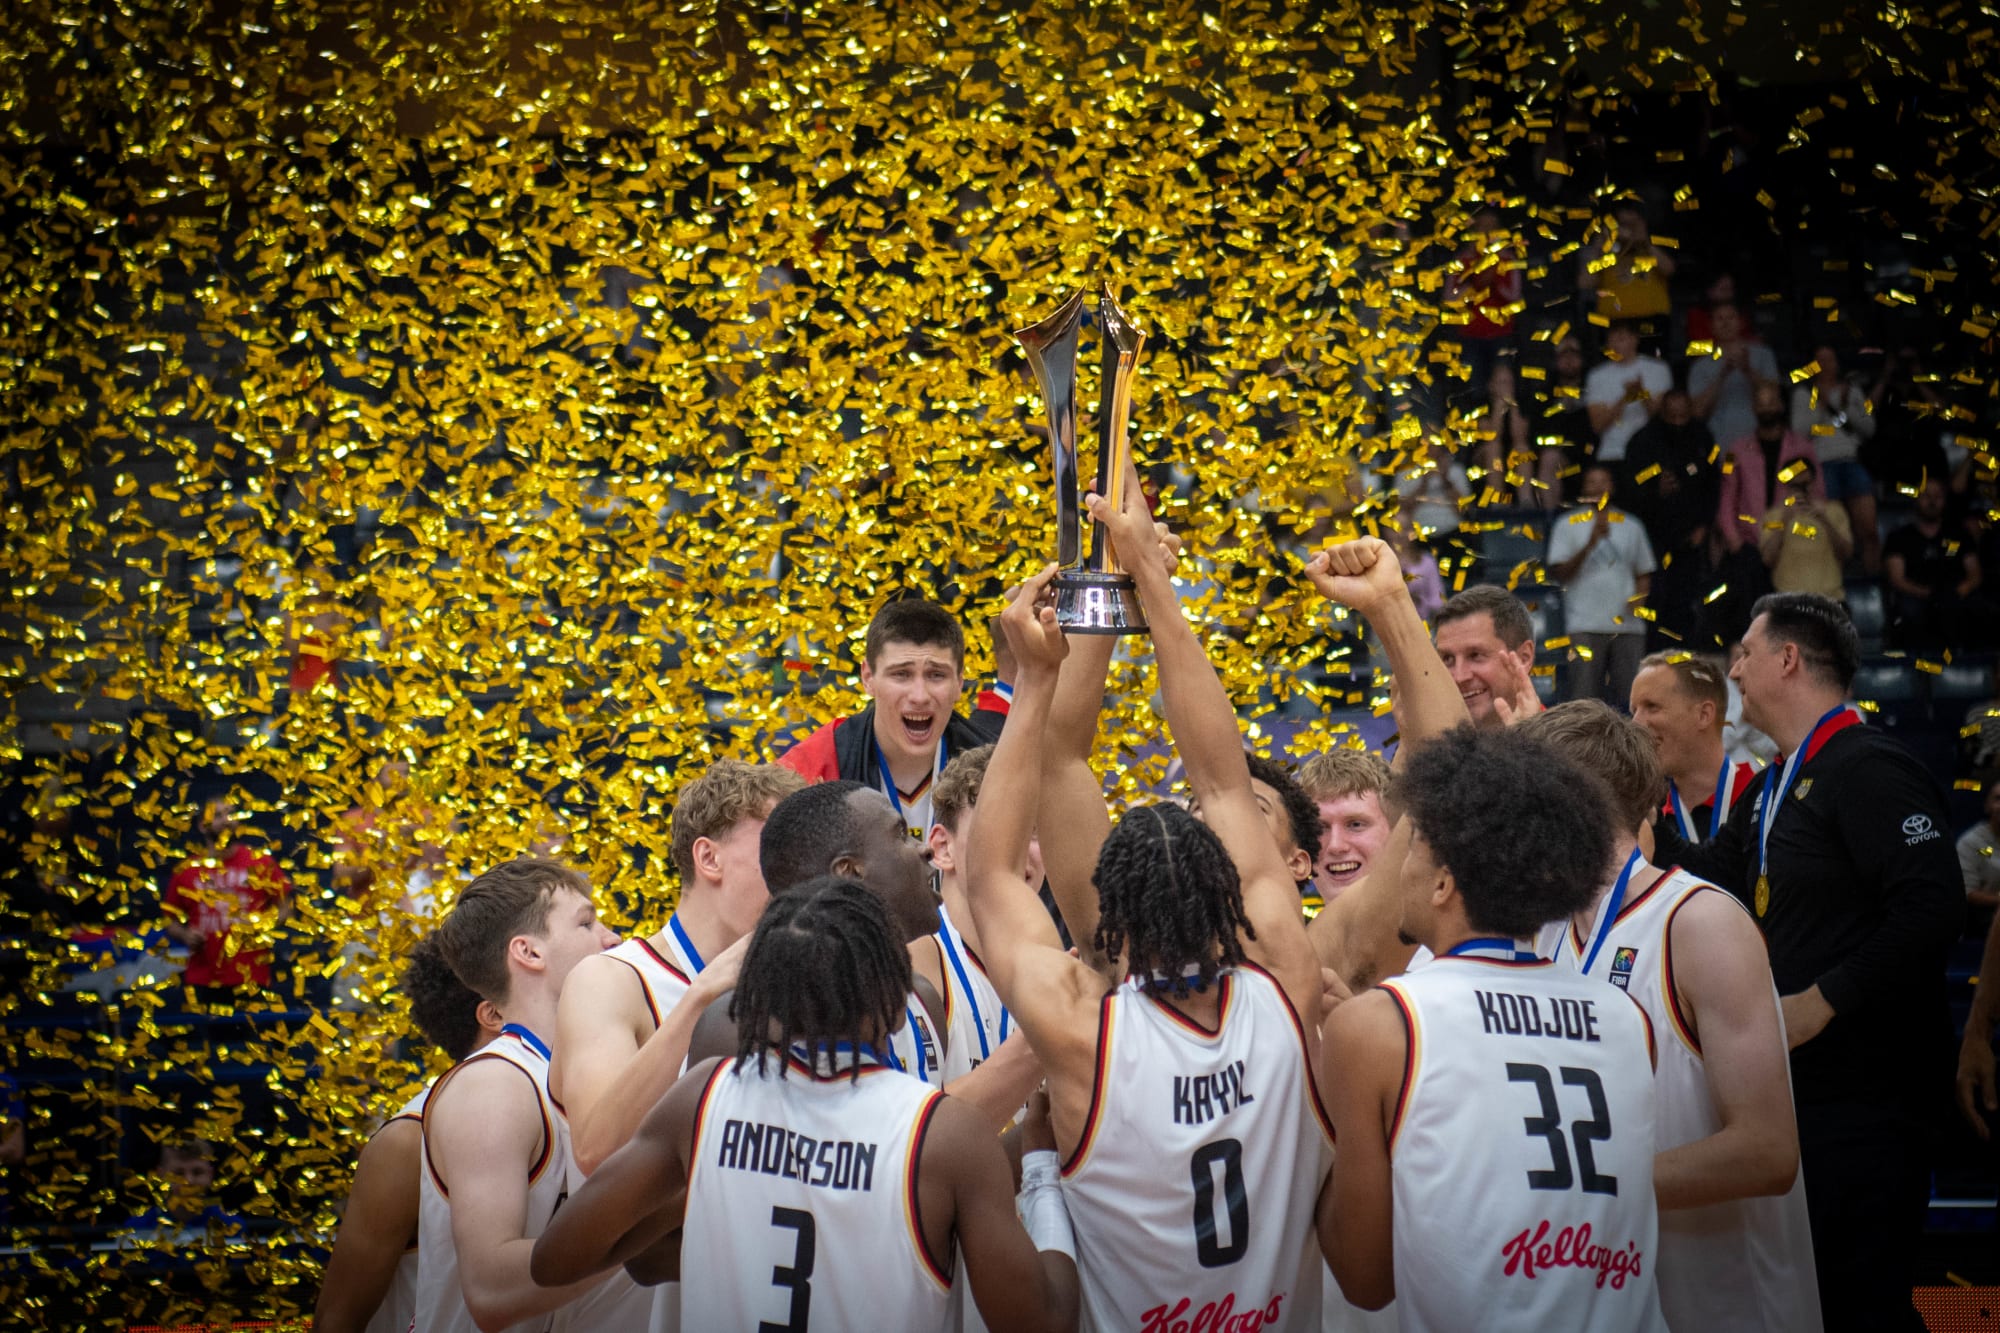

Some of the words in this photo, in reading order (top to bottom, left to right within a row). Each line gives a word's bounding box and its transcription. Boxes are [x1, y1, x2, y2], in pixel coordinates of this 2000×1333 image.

[1905, 831, 1941, 846] TOYOTA
[1475, 990, 1601, 1042] KODJOE
[1173, 1060, 1254, 1124] KAYIL
[718, 1119, 878, 1191] ANDERSON
[1506, 1062, 1618, 1198] 32
[1191, 1138, 1249, 1269] 0
[758, 1205, 816, 1333] 3
[1502, 1219, 1642, 1290] Kellogg's
